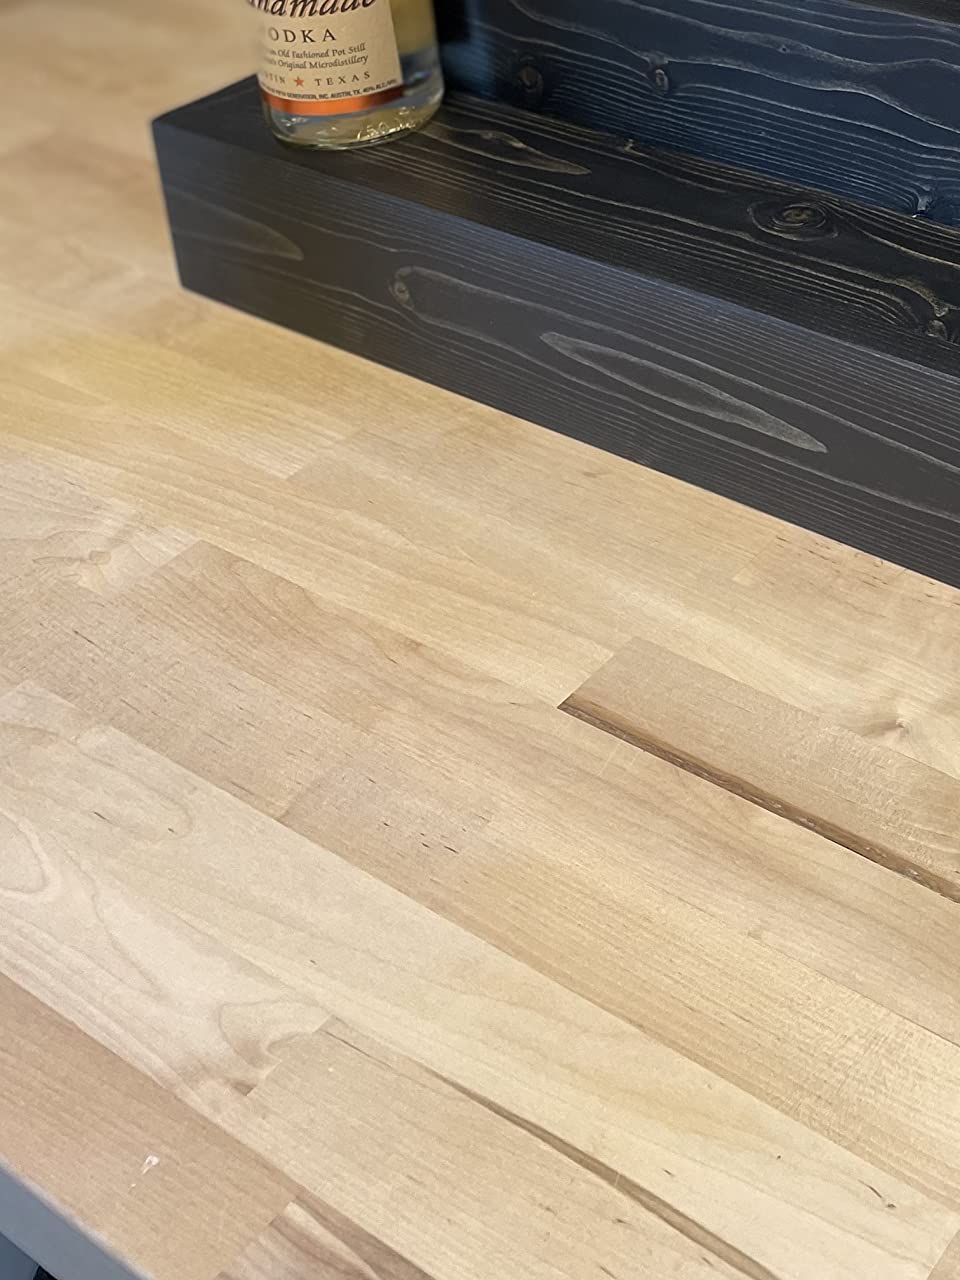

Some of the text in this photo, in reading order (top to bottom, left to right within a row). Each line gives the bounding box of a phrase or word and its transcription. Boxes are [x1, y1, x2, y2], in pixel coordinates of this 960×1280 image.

[268, 27, 336, 43] ODKA
[292, 49, 329, 59] Fashioned
[332, 49, 346, 57] Pot
[348, 43, 367, 55] Still
[278, 60, 307, 71] Original
[309, 55, 369, 69] Microdistillery
[314, 71, 371, 86] TEXAS
